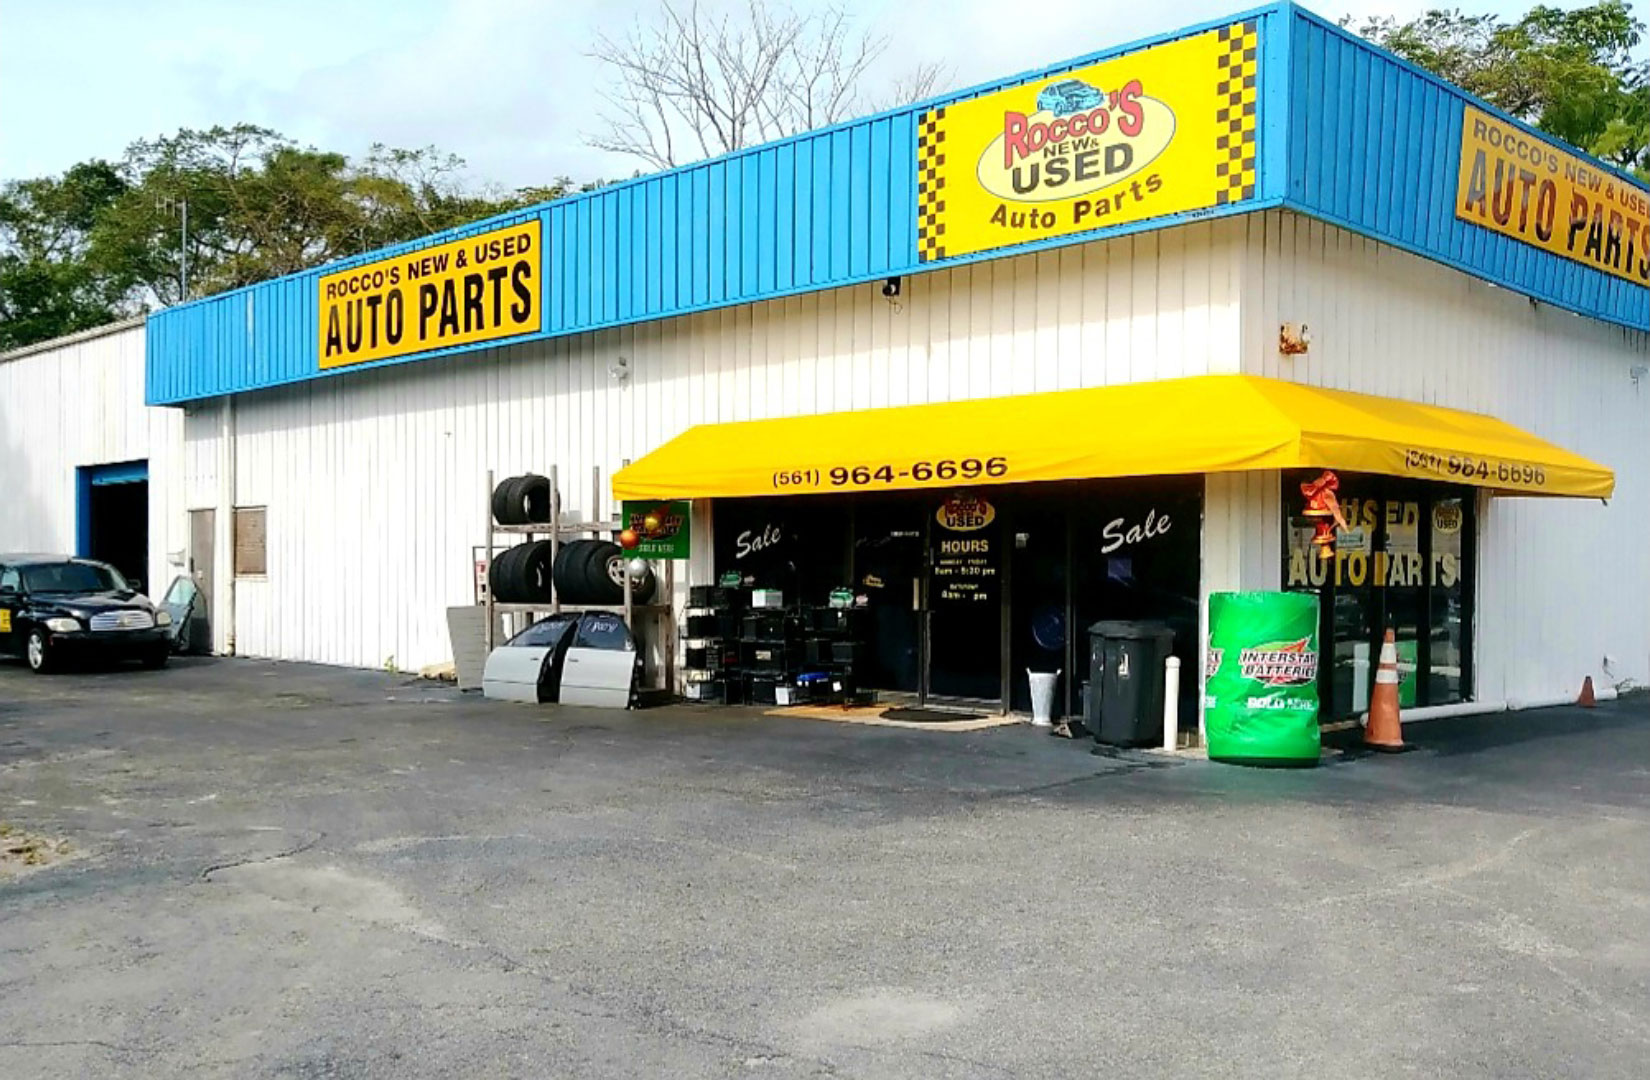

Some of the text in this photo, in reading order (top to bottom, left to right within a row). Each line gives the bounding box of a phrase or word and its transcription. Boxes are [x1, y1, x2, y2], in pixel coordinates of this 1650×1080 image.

[1004, 79, 1143, 170] ROCCO'S
[1012, 143, 1133, 194] USED
[1474, 118, 1558, 173] ROCCO'S
[1565, 161, 1602, 193] NEW
[1605, 183, 1614, 200] &
[990, 173, 1163, 229] Auto Parts
[1465, 149, 1557, 242] AUTO
[327, 233, 531, 300] ROCCO'S NEW & USED
[325, 260, 531, 357] AUTO PARTS
[773, 456, 1008, 488] (561) 964-6696
[1447, 455, 1545, 486] 964-6696
[946, 516, 984, 527] USED
[1101, 508, 1171, 554] Sale
[1340, 499, 1419, 534] USED
[736, 523, 782, 559] Sale
[941, 540, 989, 553] HOURS
[1288, 549, 1367, 586] AUTO
